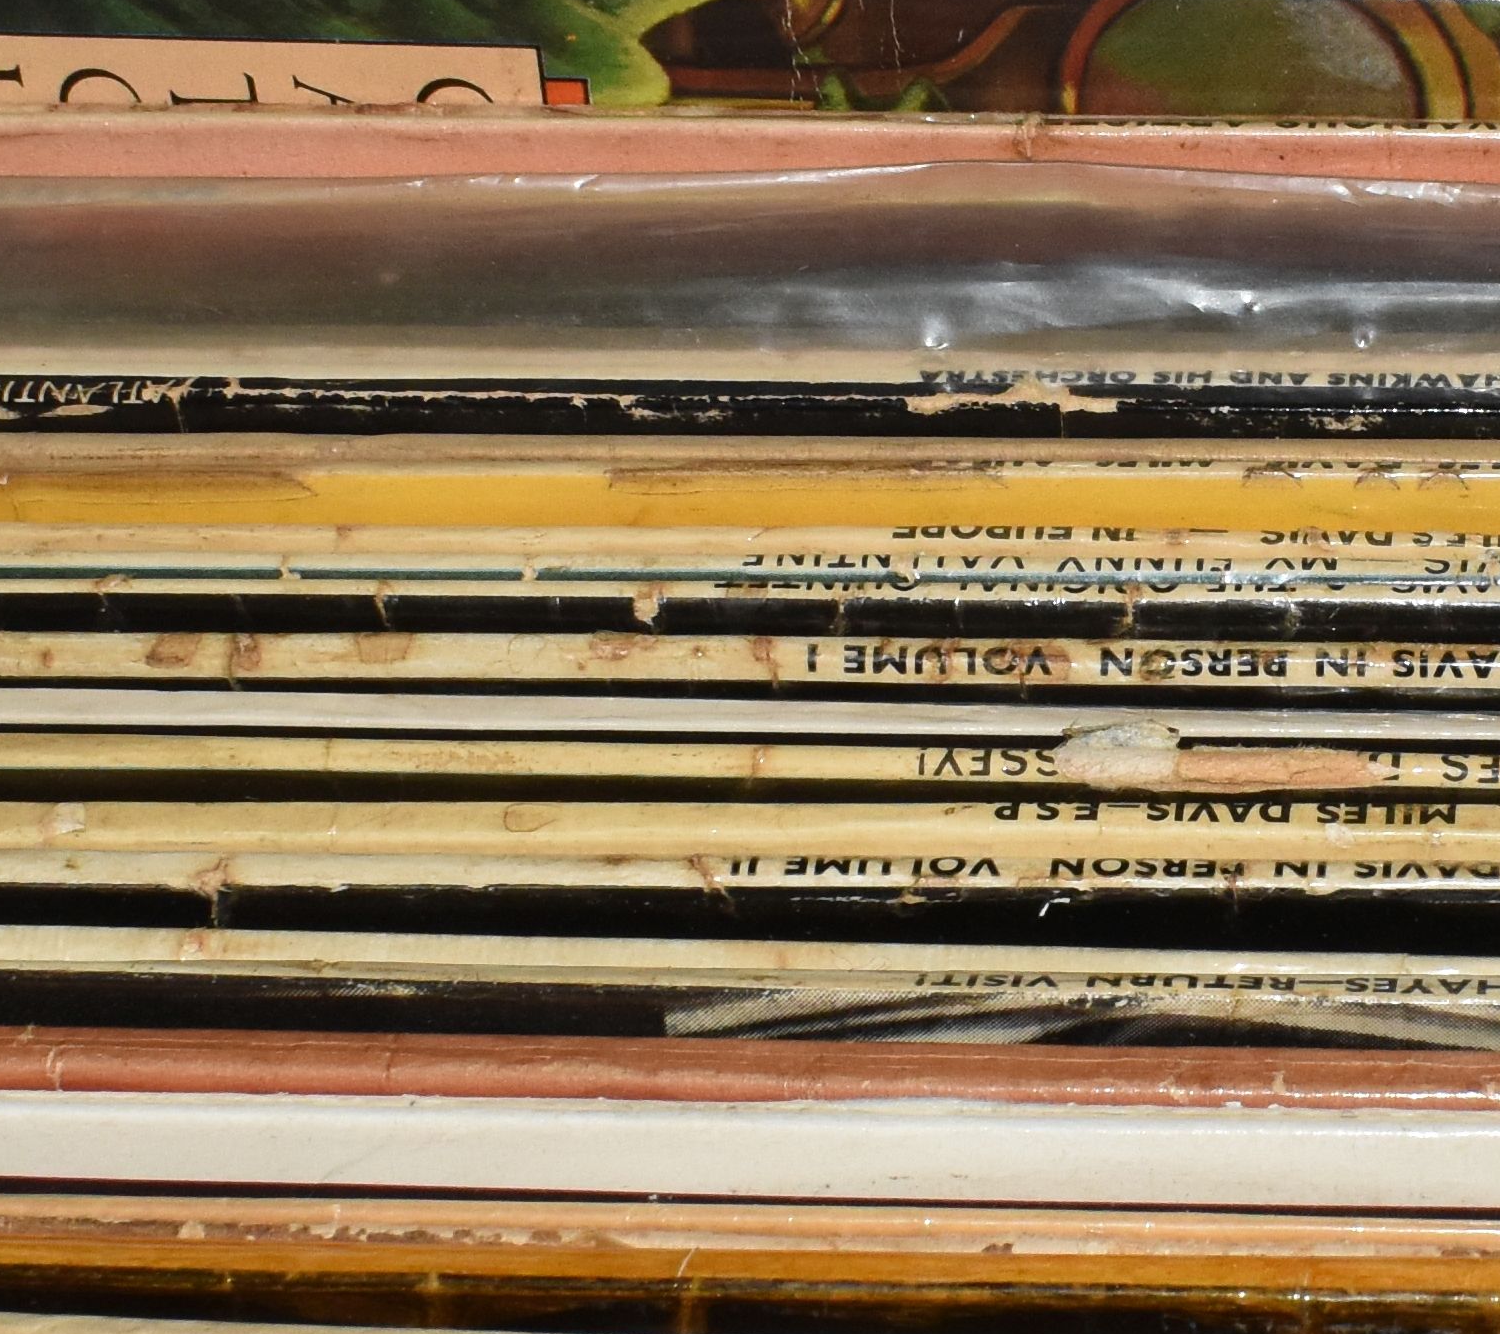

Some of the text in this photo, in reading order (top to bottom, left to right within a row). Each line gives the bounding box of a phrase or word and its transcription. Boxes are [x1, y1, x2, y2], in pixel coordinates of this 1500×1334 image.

[1229, 368, 1308, 386] AND
[840, 643, 1071, 678] VOLUME
[1098, 645, 1290, 680] PERSON
[1315, 647, 1368, 680] IN
[1316, 803, 1458, 826] MILES
